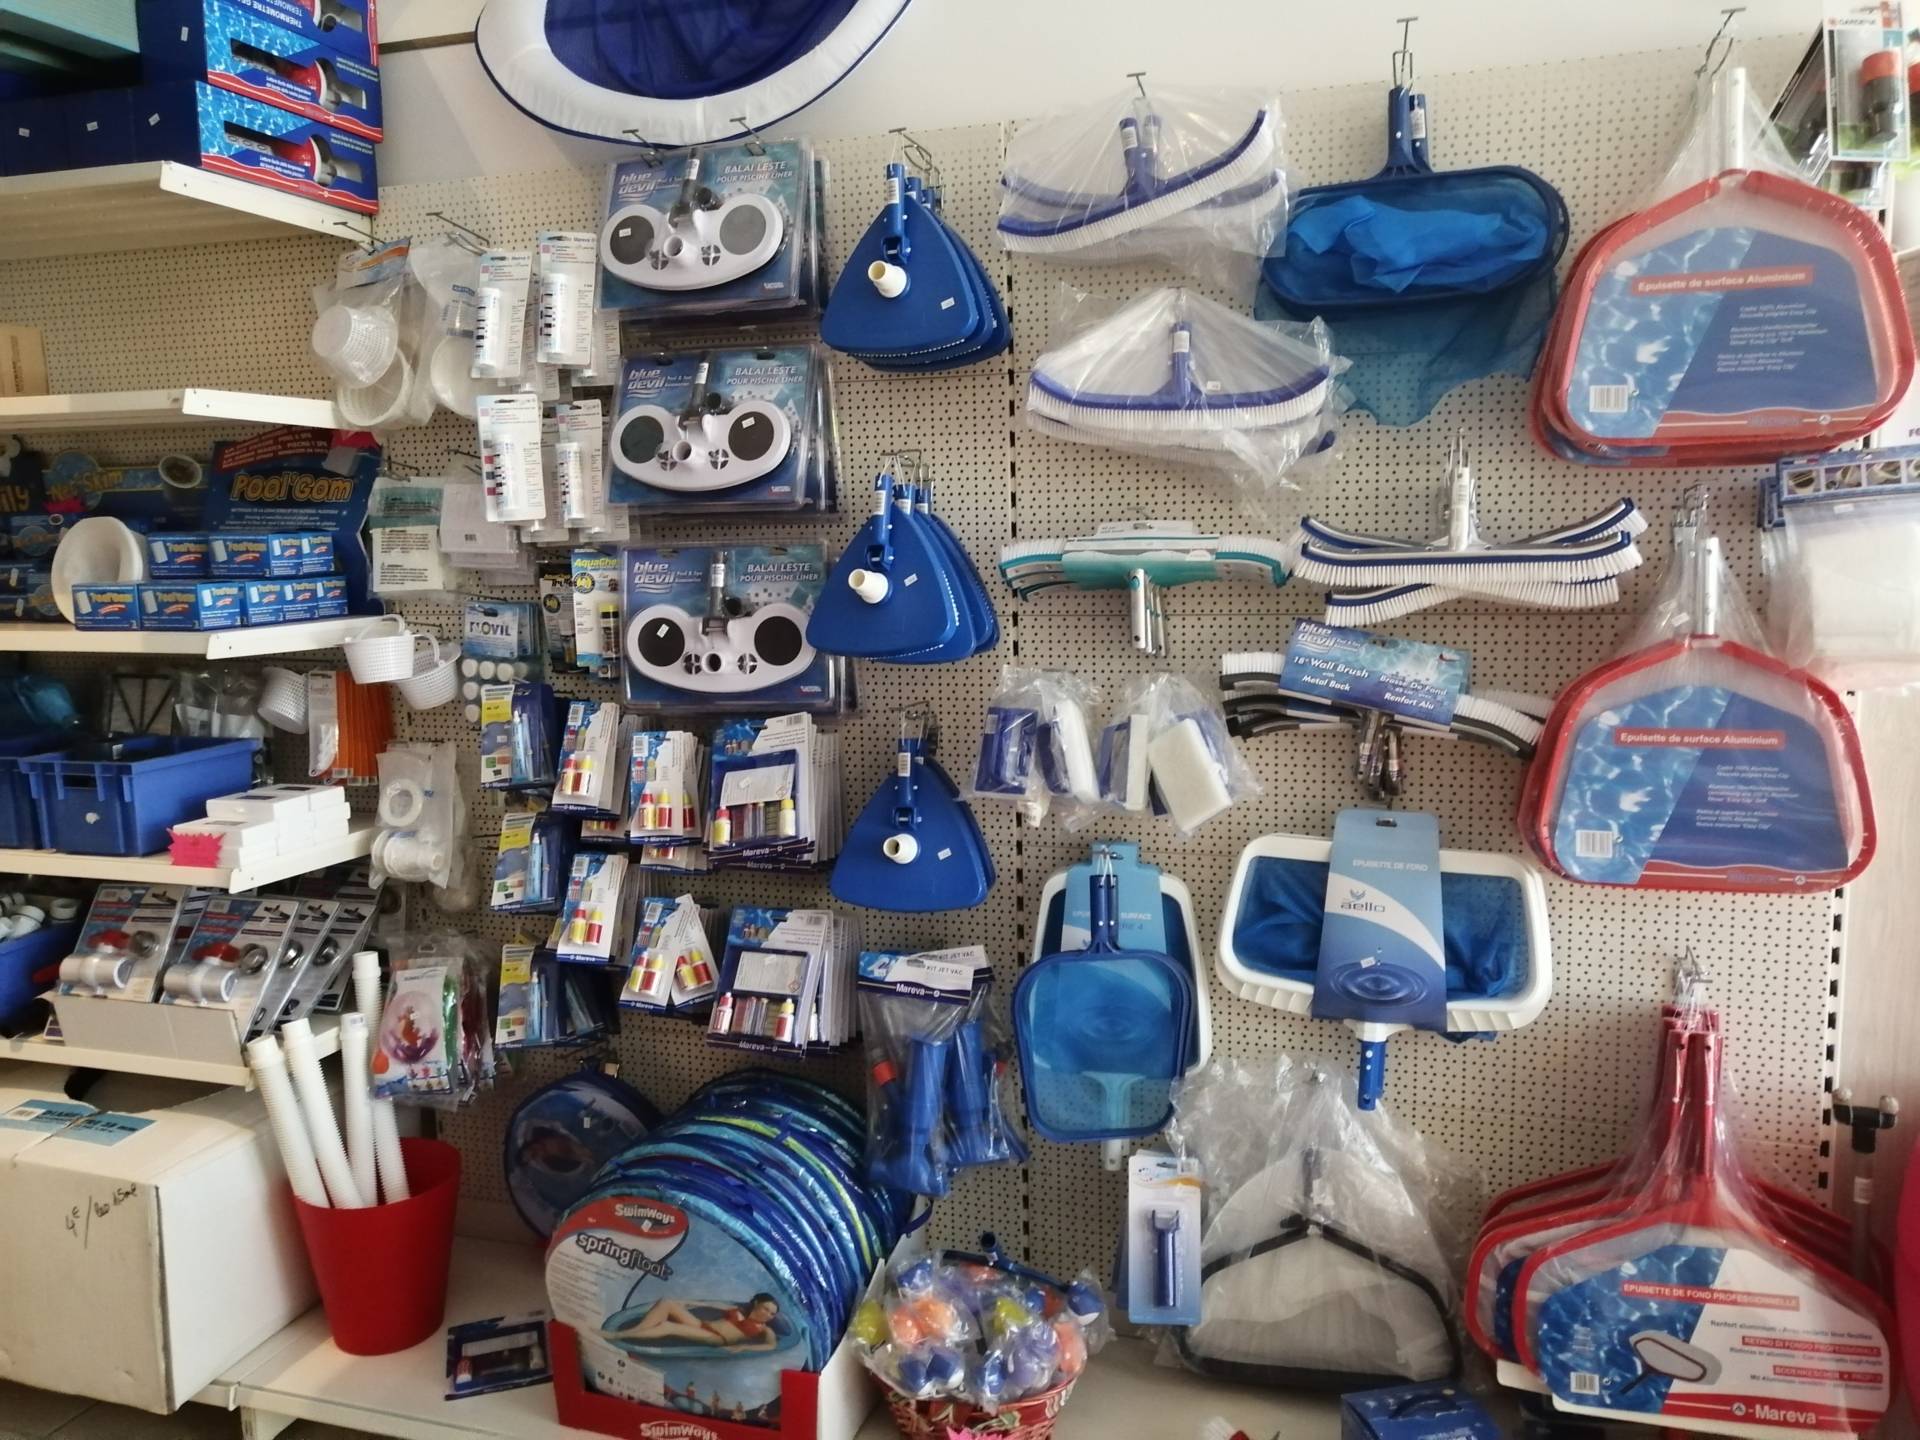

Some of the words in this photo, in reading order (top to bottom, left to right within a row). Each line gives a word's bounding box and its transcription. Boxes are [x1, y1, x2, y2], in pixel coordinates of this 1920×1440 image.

[724, 164, 753, 174] BALAI
[757, 161, 786, 171] LESTE
[620, 172, 652, 184] blue
[618, 180, 657, 193] devil
[1638, 279, 1686, 292] Epuisette
[1689, 278, 1703, 288] de
[1705, 275, 1744, 287] surface
[1747, 271, 1806, 284] Aluminium
[629, 368, 661, 380] blue
[735, 367, 764, 376] BALAI
[767, 365, 797, 375] LESTE
[627, 376, 666, 390] devil
[727, 377, 749, 385] POUR
[750, 376, 779, 384] PISCINE
[634, 561, 669, 574] blue
[747, 563, 778, 573] BALAI
[781, 562, 810, 572] LESTE
[634, 571, 676, 585] devil
[740, 574, 762, 582] POUR
[764, 573, 794, 582] PISCINE
[1299, 622, 1332, 635] blue
[1298, 632, 1336, 647] devil
[1311, 658, 1335, 670] Wall
[1337, 664, 1369, 679] Brush
[1302, 675, 1328, 687] Metal
[1329, 680, 1352, 692] Back
[1410, 682, 1423, 690] De
[1425, 686, 1448, 696] Fond
[1384, 692, 1418, 707] Renfort
[1418, 700, 1435, 711] Alu
[1621, 732, 1667, 745] Epuisette
[1669, 733, 1682, 743] de
[1684, 733, 1720, 744] surface
[1722, 734, 1778, 746] Aluminium
[742, 847, 770, 857] Mareva
[1393, 862, 1404, 870] DE
[1340, 900, 1386, 913] aello
[962, 950, 975, 958] VAC
[895, 983, 926, 997] Mareva
[738, 1041, 765, 1052] Mareva
[615, 1203, 676, 1225] SwimWays
[1623, 1283, 1670, 1296] EPUISETTE
[1672, 1288, 1685, 1297] DE
[1687, 1290, 1711, 1300] FOND
[1755, 1404, 1817, 1425] Mareva
